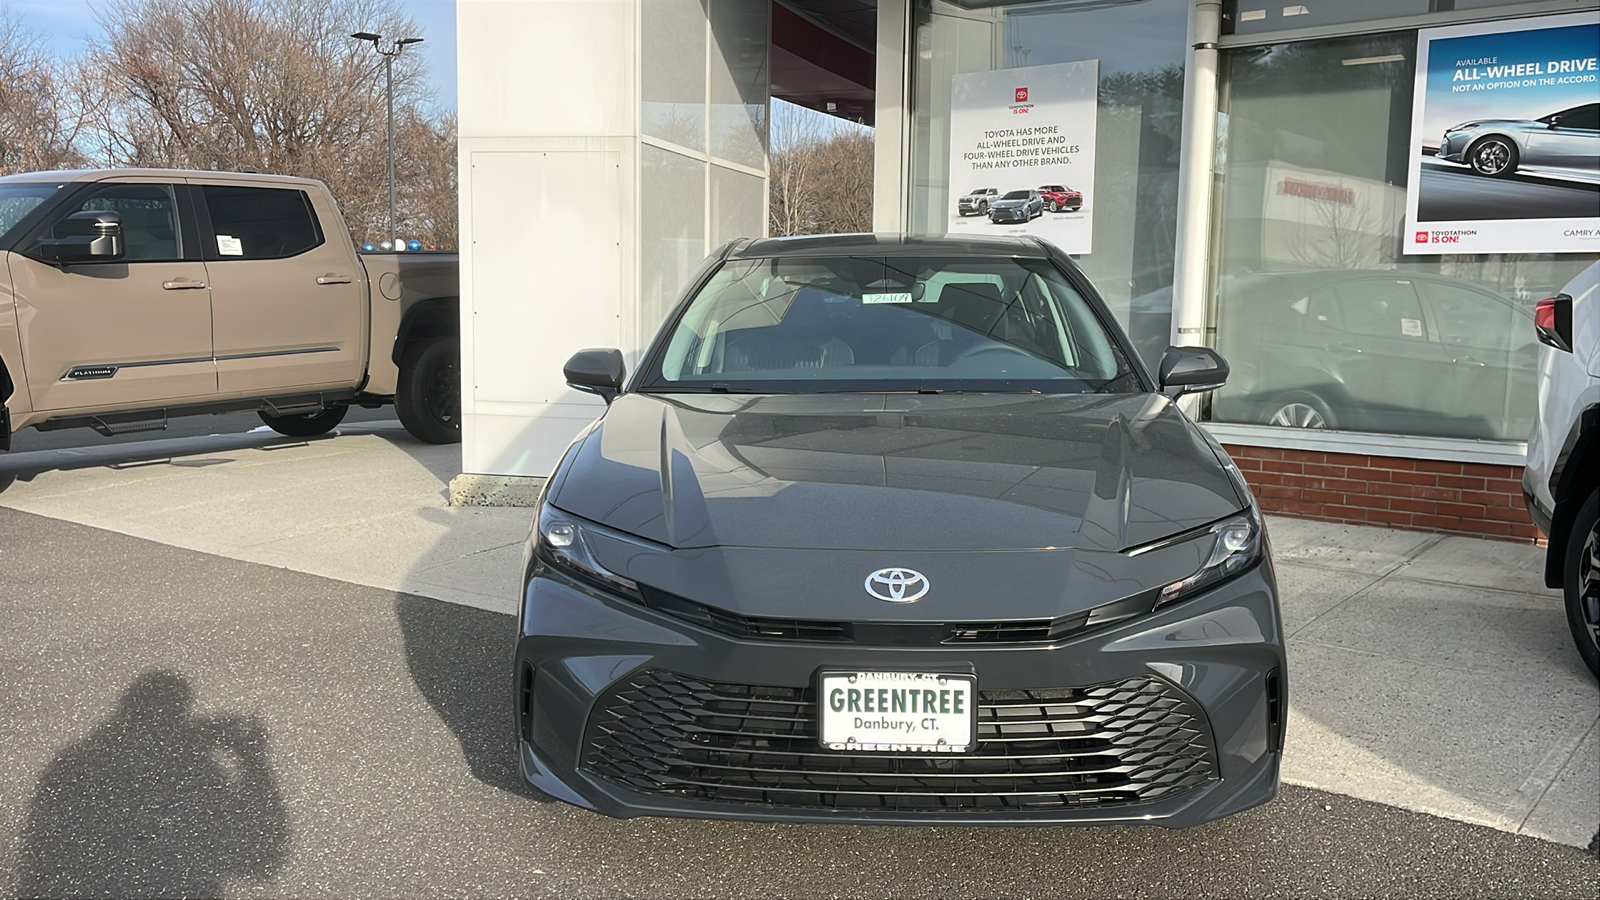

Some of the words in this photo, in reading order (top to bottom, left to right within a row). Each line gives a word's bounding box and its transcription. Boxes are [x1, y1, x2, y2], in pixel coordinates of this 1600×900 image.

[1455, 56, 1498, 67] AVAILABLE
[1452, 63, 1544, 82] ALL-WHEEL
[1547, 57, 1599, 74] DRIVE.
[1452, 84, 1471, 93] NOT
[1472, 83, 1485, 91] AN
[1486, 80, 1520, 90] OPTION
[1522, 79, 1537, 87] ON
[1539, 77, 1556, 86] THE
[1557, 74, 1598, 84] ACCORD.
[984, 129, 1015, 139] TOYOTA
[1016, 127, 1033, 136] HAS
[1034, 125, 1058, 135] MORE
[976, 139, 1021, 149] ALL-WHEEL
[1022, 137, 1046, 147] DRIVE
[1047, 135, 1066, 145] AND
[963, 150, 1015, 161] FOUR-WHEEL
[1016, 147, 1040, 157] DRIVE
[1041, 145, 1080, 156] VEHICLES
[972, 161, 993, 170] THAN
[994, 160, 1011, 169] ANY
[1012, 158, 1039, 168] OTHER
[1040, 156, 1072, 166] BRAND.
[1431, 236, 1440, 244] IS
[1441, 236, 1459, 244] ON!
[1563, 229, 1593, 237] CAMRY
[829, 688, 964, 714] GREENTREE
[854, 716, 916, 733] Danbury,
[921, 718, 939, 730] CT.
[829, 743, 966, 752] GREENTREE
